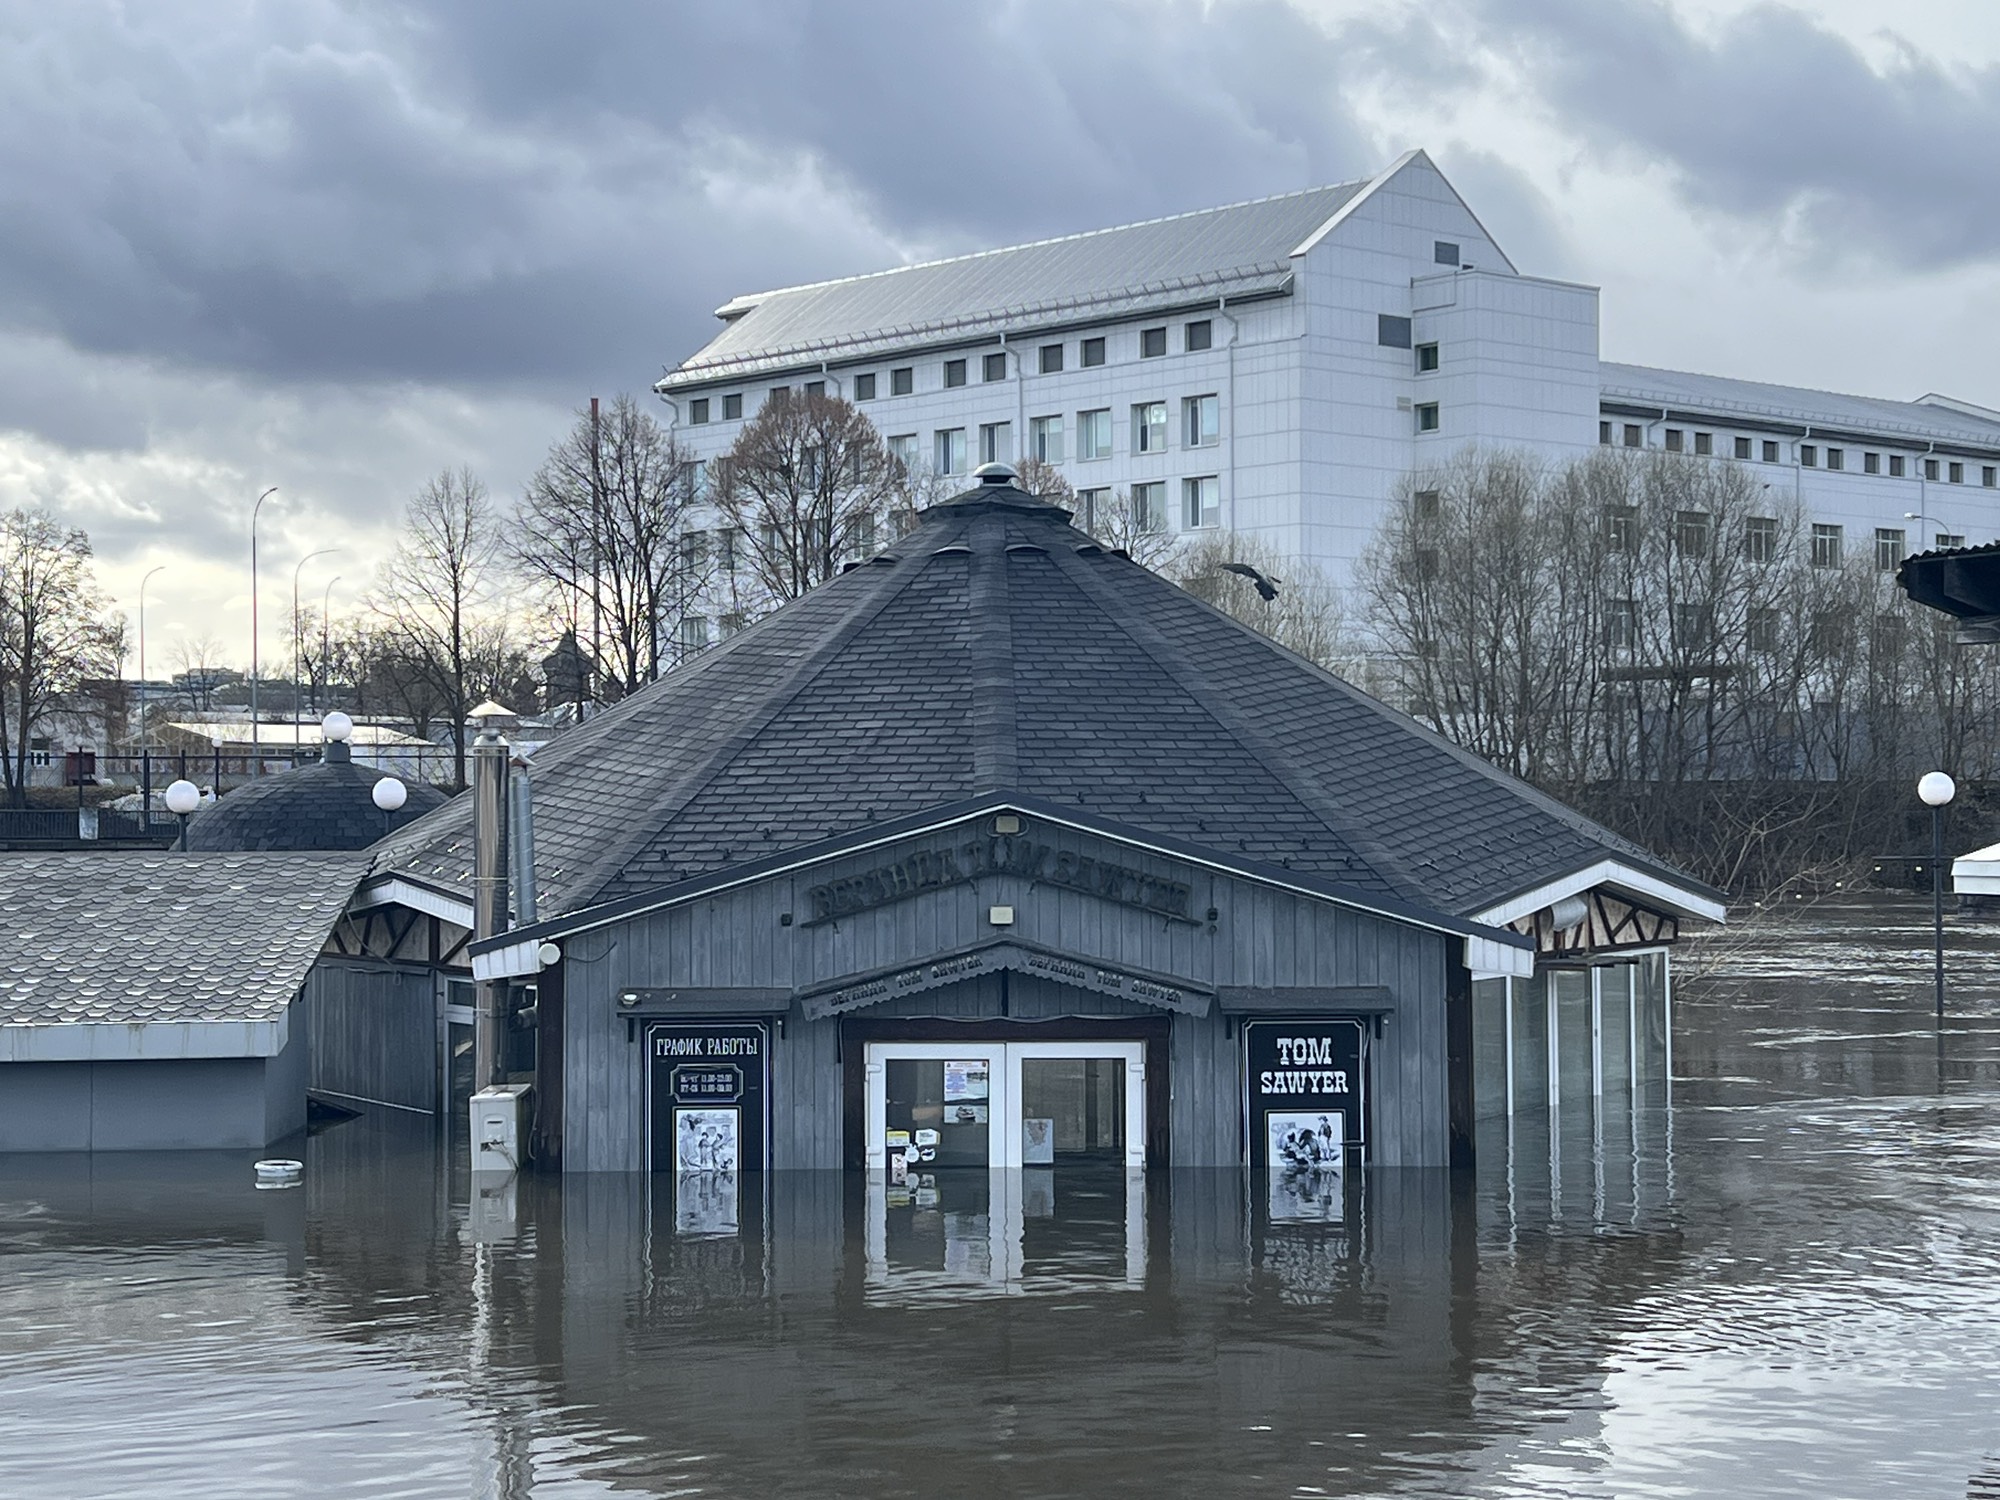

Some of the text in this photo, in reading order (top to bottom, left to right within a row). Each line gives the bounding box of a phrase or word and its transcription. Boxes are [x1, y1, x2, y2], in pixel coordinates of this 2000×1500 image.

[656, 1037, 758, 1056] ГРАФИК РАБОТЫ
[1277, 1037, 1332, 1066] TOM
[1260, 1071, 1349, 1094] SAWYER
